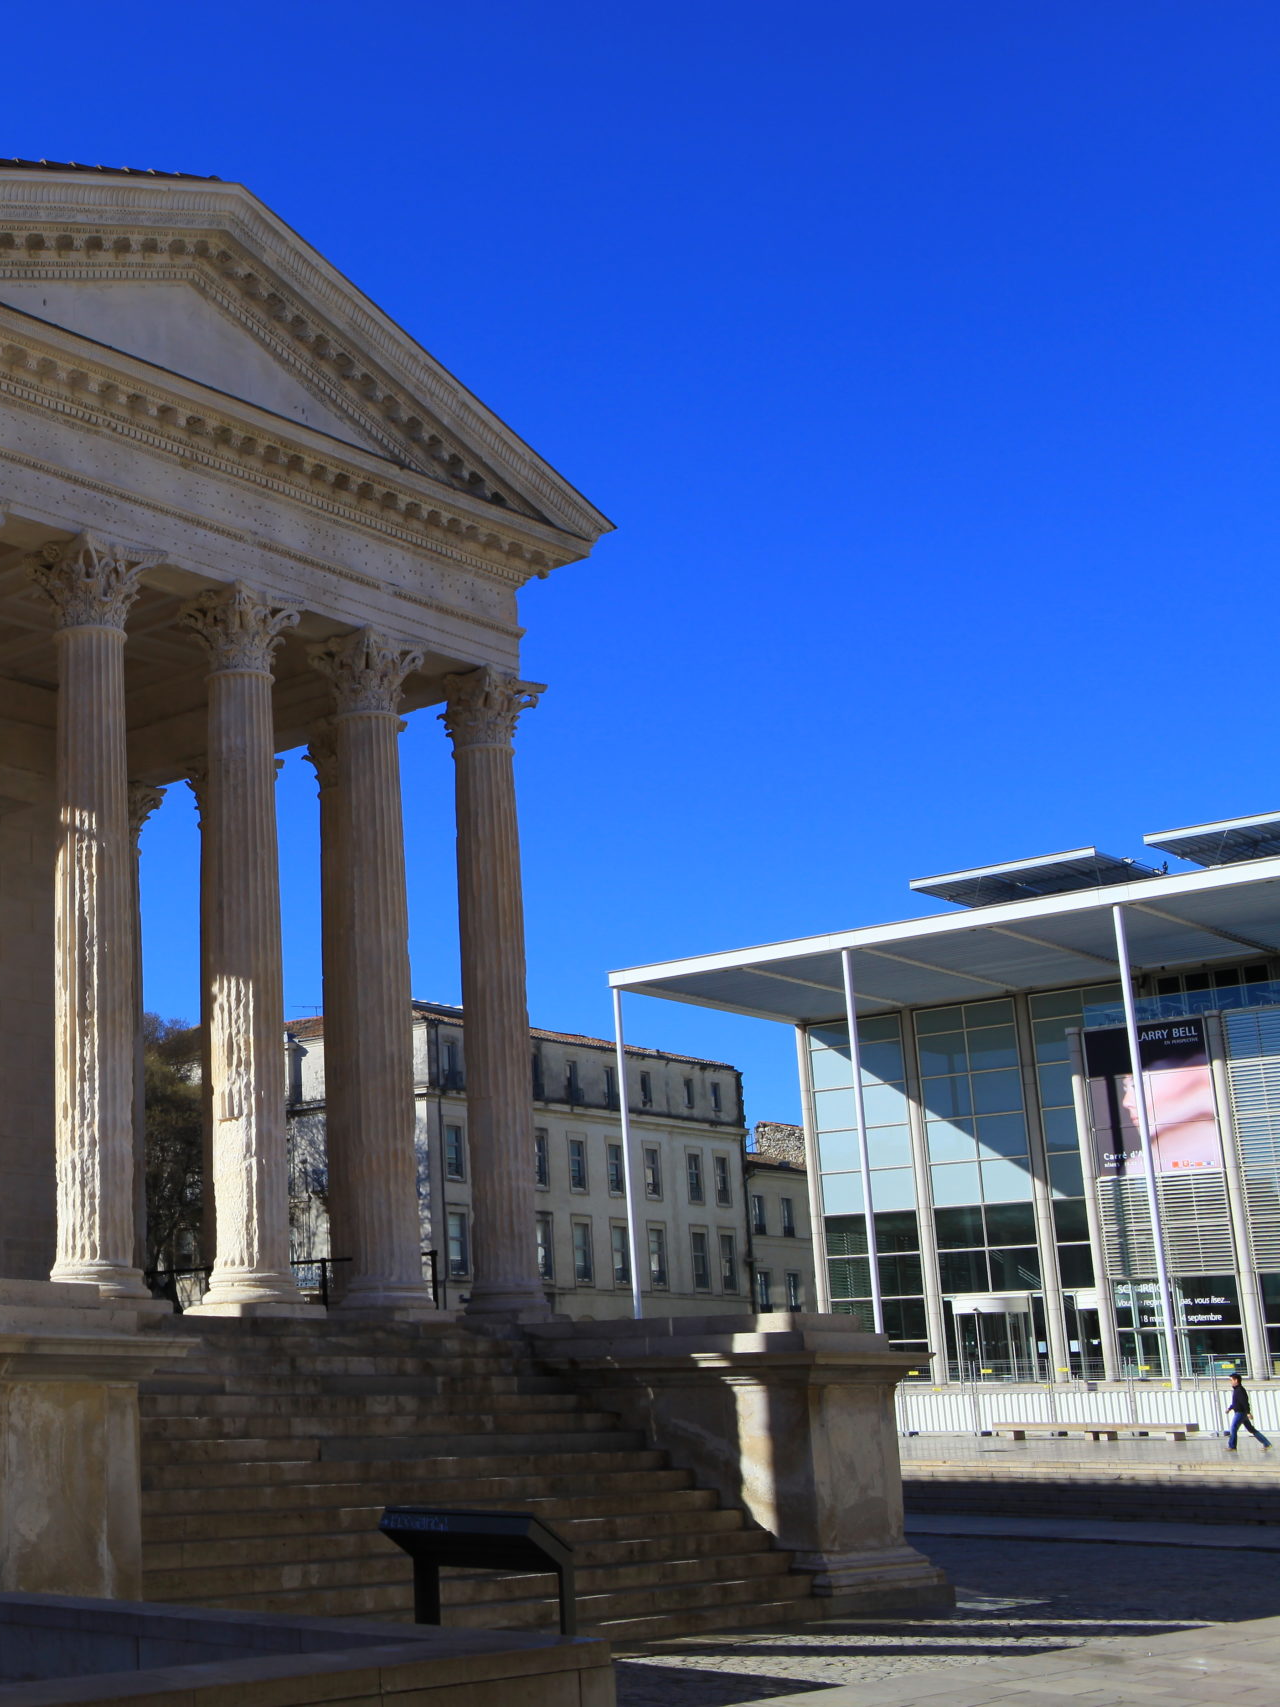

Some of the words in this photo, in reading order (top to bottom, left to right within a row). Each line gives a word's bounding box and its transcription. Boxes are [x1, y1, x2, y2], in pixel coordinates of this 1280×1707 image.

[1172, 1026, 1198, 1038] BELL
[1103, 1151, 1127, 1161] Carré
[1180, 1297, 1193, 1306] pas,
[1194, 1296, 1209, 1304] vous
[1187, 1313, 1222, 1324] septembre
